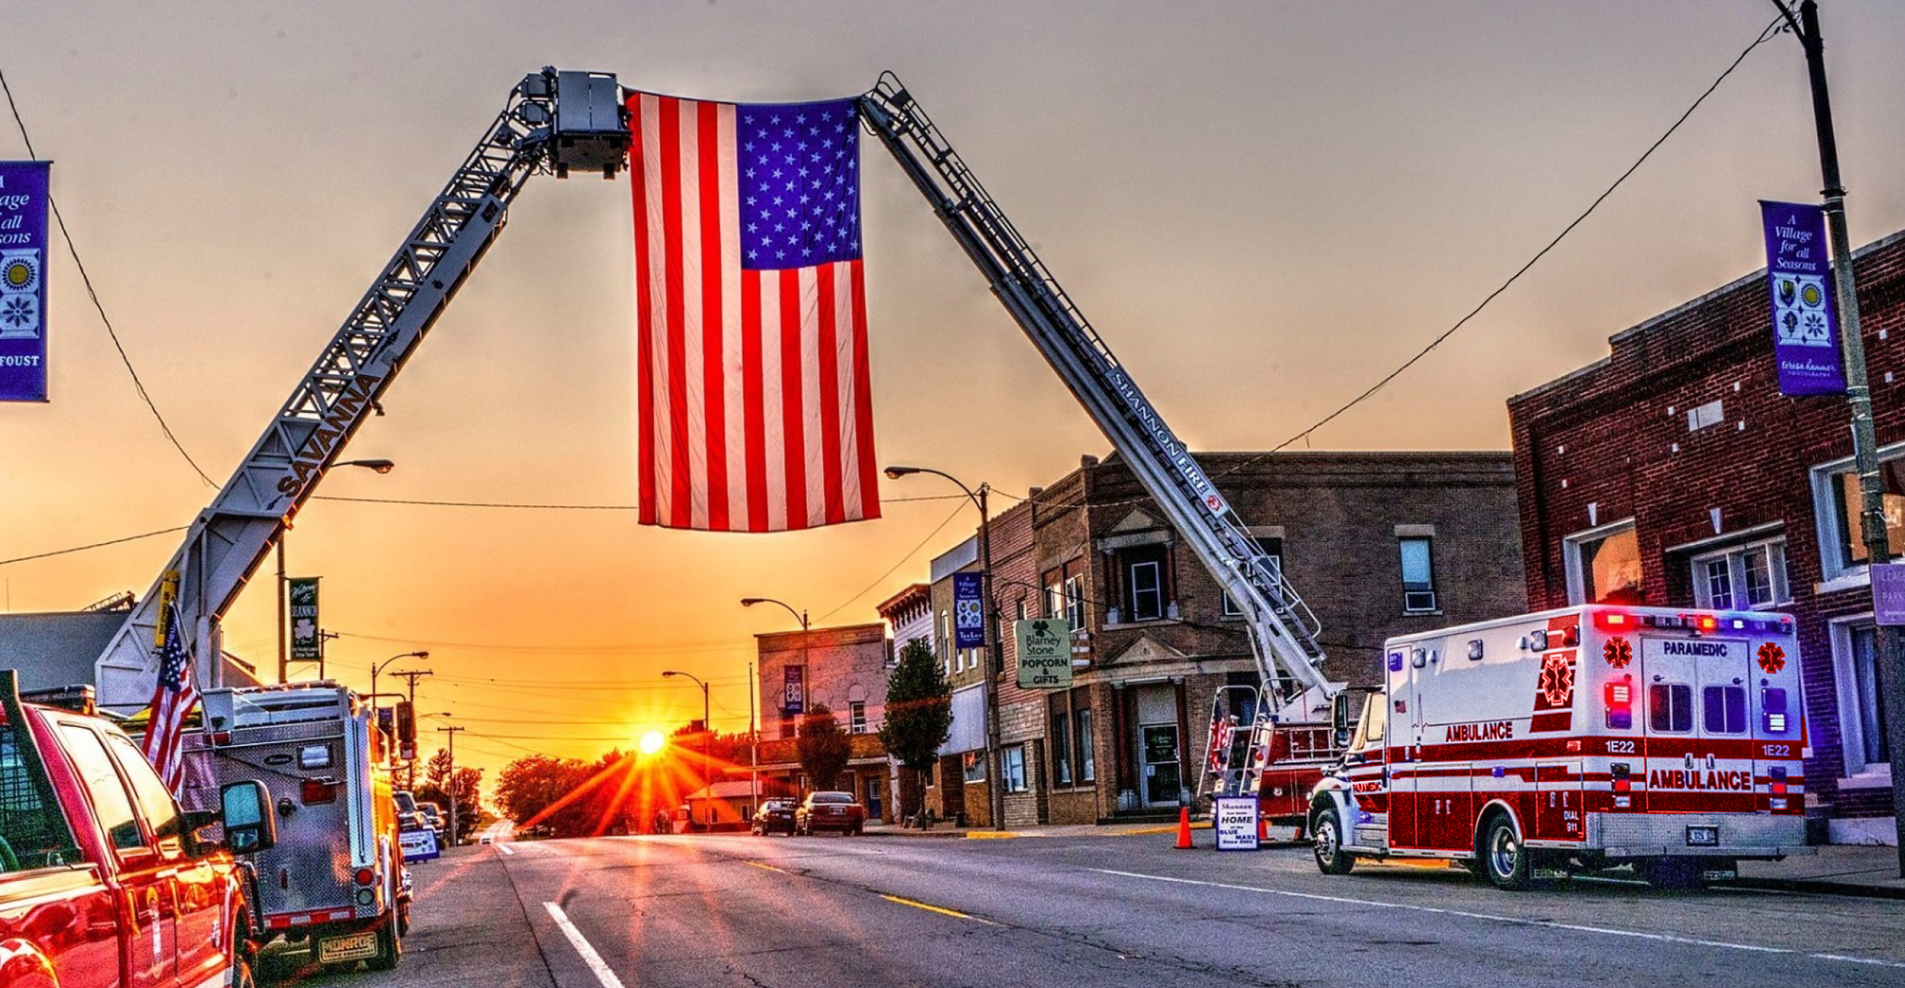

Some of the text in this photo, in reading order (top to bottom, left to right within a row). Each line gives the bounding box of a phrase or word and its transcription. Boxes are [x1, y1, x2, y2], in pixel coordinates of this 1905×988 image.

[1, 215, 23, 229] all
[1787, 214, 1796, 225] A
[1775, 226, 1813, 243] Village
[1779, 240, 1810, 259] for all
[1776, 257, 1817, 271] Seasons
[0, 355, 40, 366] FOUST
[277, 374, 381, 498] SAVANNA
[1112, 373, 1210, 495] SHANNON FIRE
[1026, 635, 1061, 648] Blarney
[1027, 646, 1054, 655] Stone
[1664, 642, 1727, 657] PARAMEDIC
[1022, 658, 1068, 668] POPCORN
[1033, 675, 1059, 684] GIFTS
[1445, 721, 1513, 742] AMBULANCE
[1605, 741, 1635, 753] 1E22
[1761, 744, 1790, 757] 1E22
[1649, 769, 1752, 790] AMBULANCE
[1221, 816, 1253, 824] HOME
[1563, 810, 1579, 820] DIAL
[1567, 822, 1578, 832] 911
